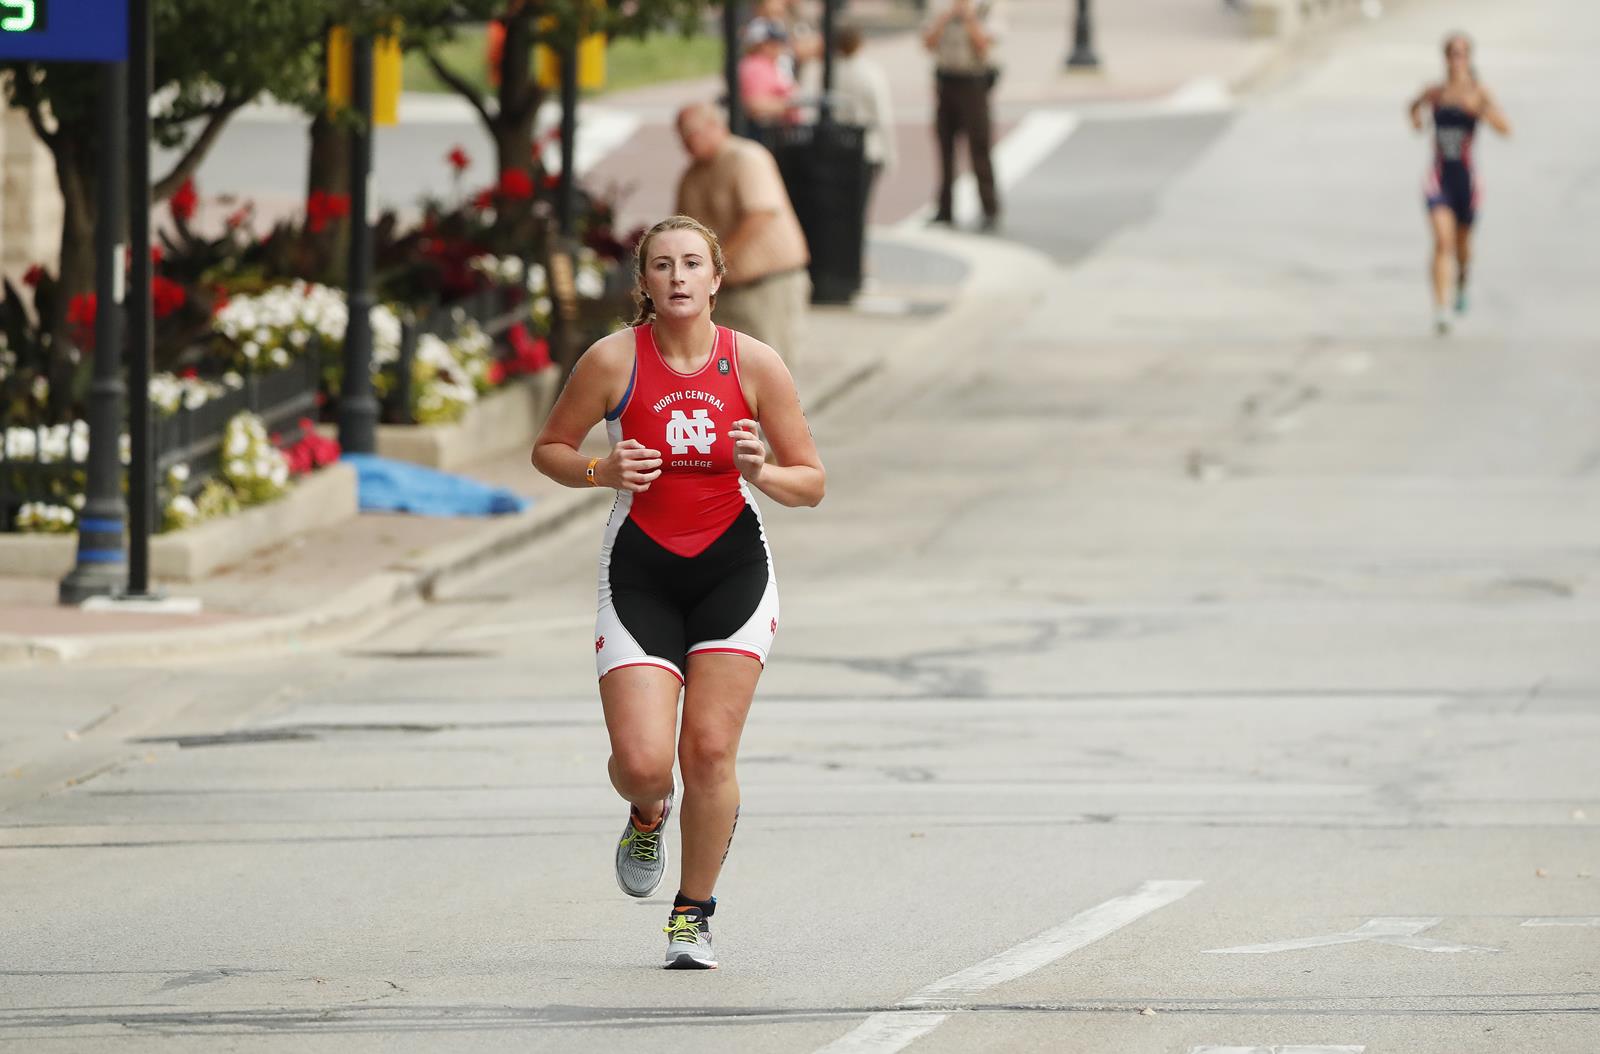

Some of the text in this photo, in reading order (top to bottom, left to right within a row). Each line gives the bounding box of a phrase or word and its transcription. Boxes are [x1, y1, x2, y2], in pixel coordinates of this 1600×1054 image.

[653, 390, 725, 413] NORTH CENTRAL
[671, 460, 713, 468] COLLEGE
